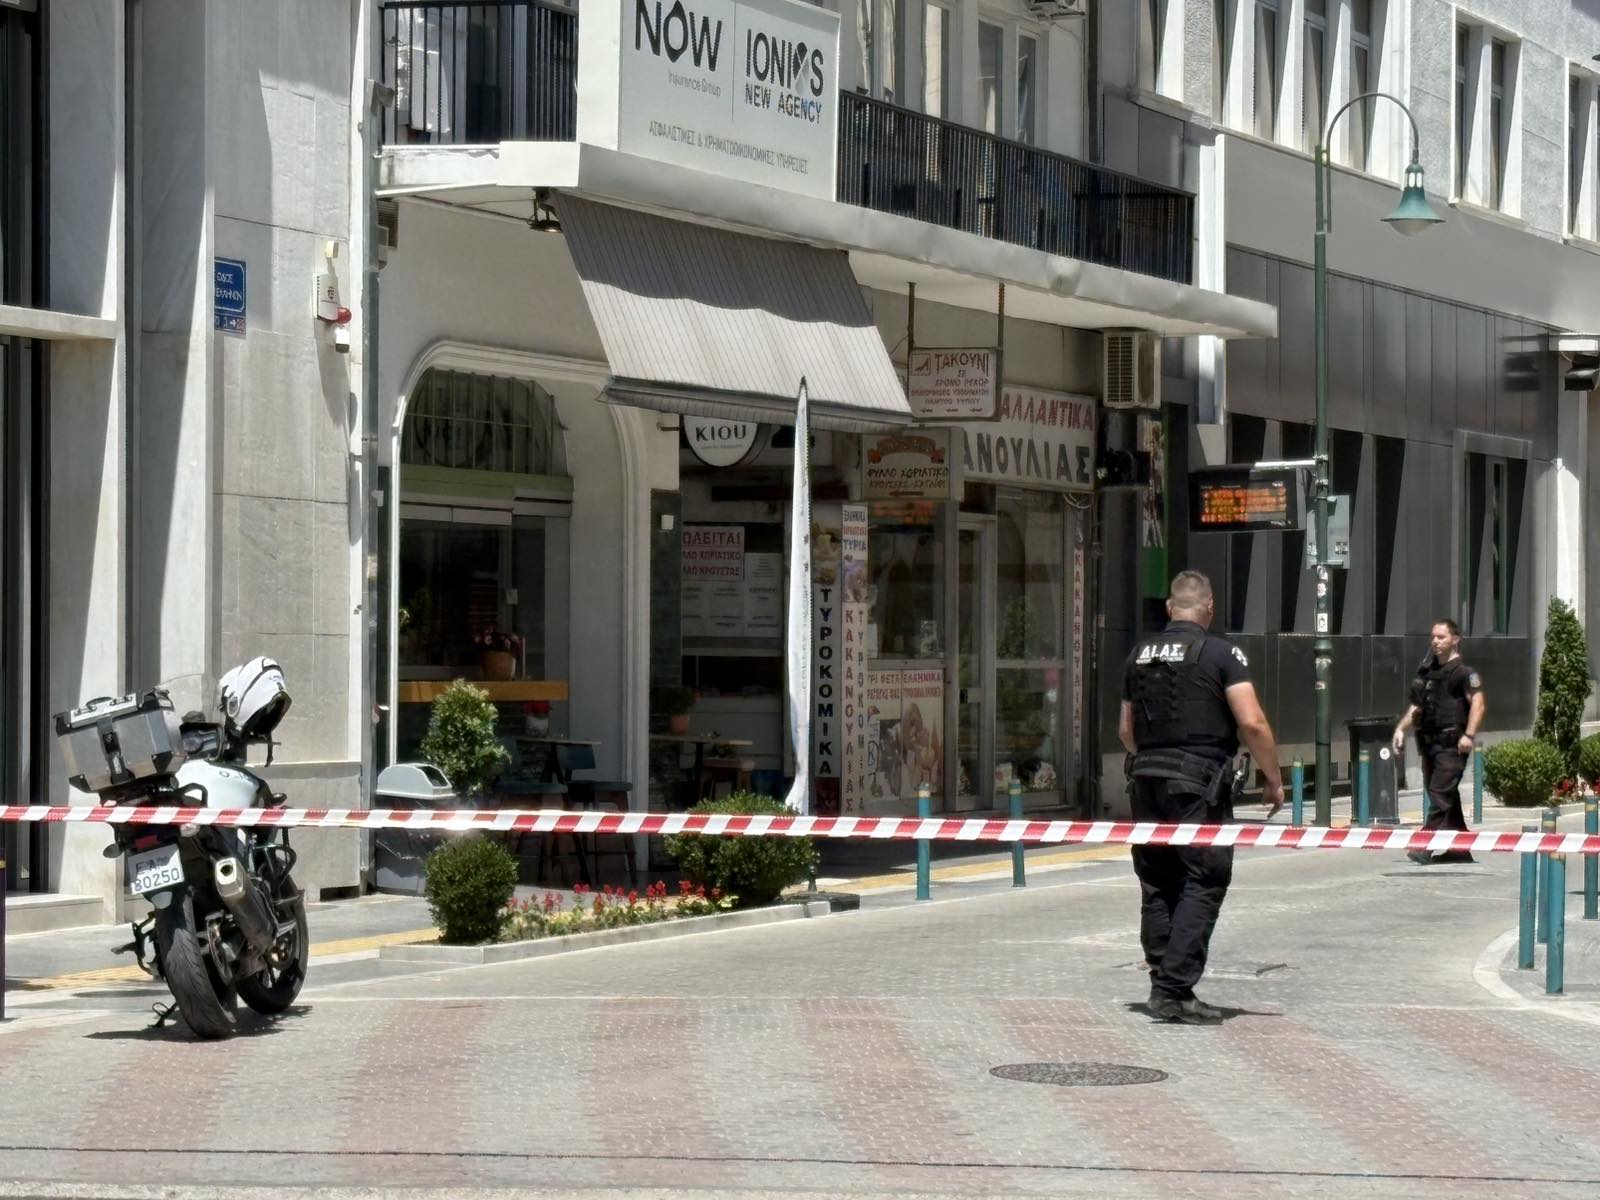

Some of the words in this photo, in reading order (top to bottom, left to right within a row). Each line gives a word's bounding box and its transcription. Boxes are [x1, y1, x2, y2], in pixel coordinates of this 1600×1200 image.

[635, 0, 722, 72] NOW
[745, 83, 771, 110] NEW
[778, 94, 822, 124] AGENCY
[934, 352, 989, 377] ΤΑΚΟΥΝΙ
[1000, 392, 1094, 432] ΑΛΛΑΝΤΙΚΑ
[695, 424, 746, 442] KIOU
[818, 587, 834, 776] ΤΥΡΟΚΟΜΙΚΑ
[134, 867, 180, 892] 80250
